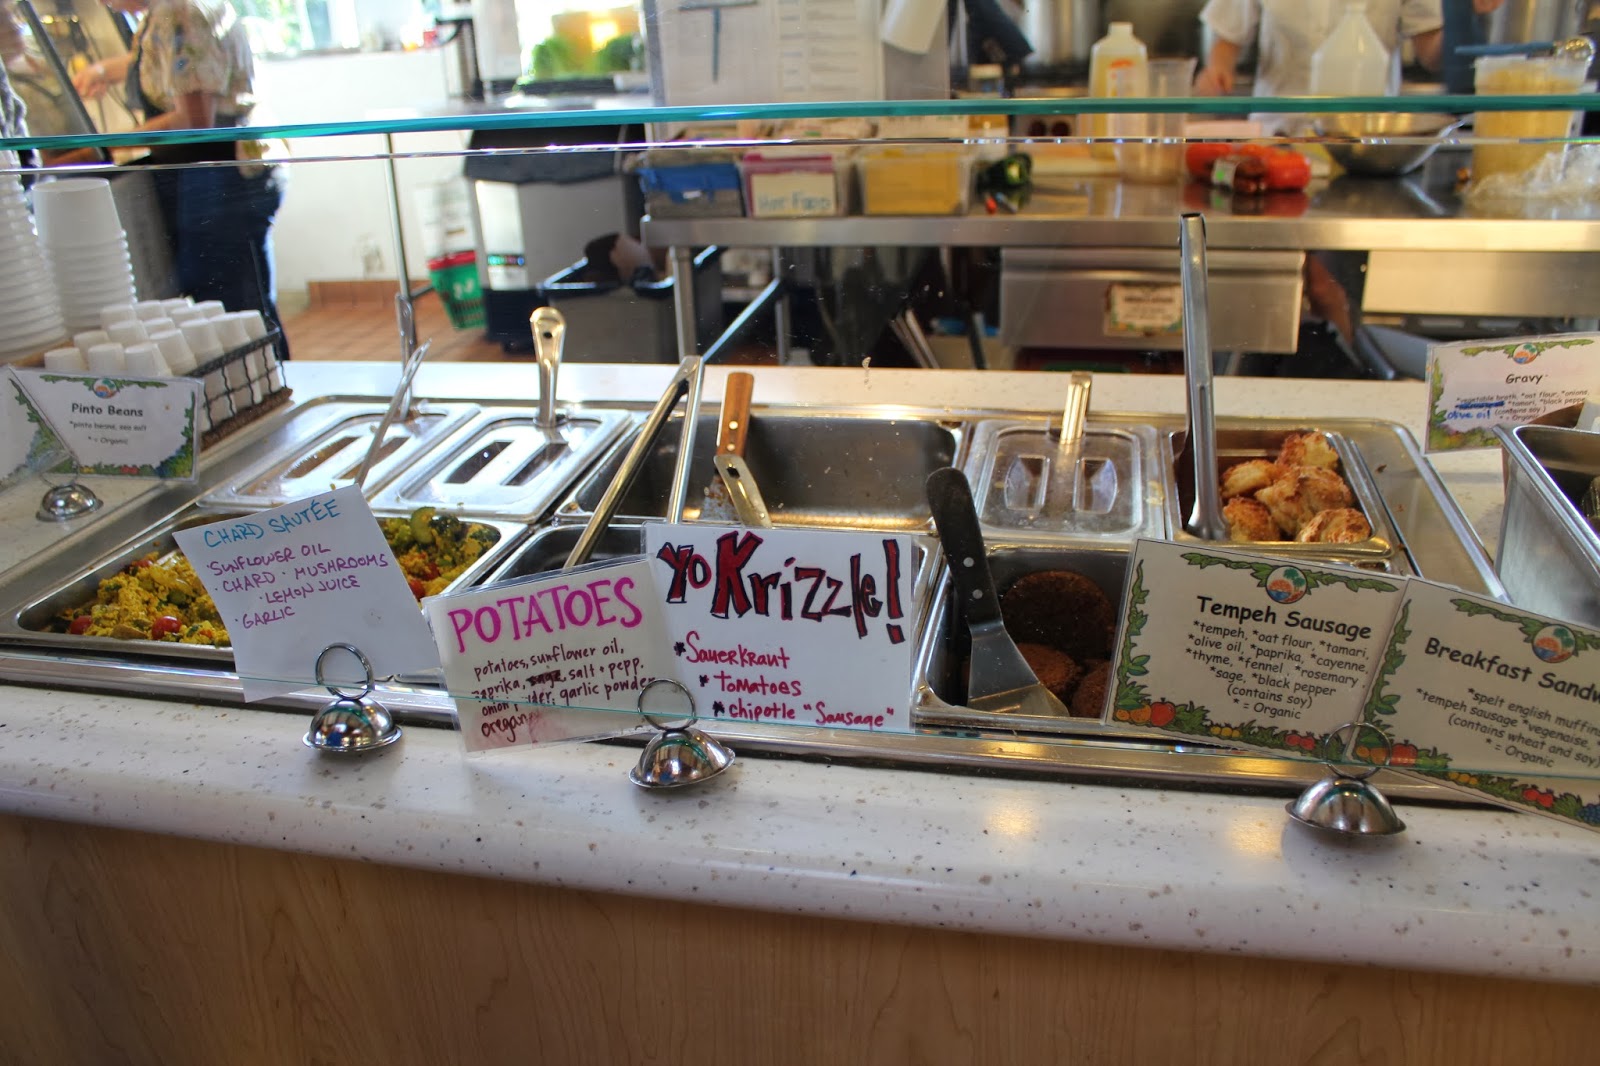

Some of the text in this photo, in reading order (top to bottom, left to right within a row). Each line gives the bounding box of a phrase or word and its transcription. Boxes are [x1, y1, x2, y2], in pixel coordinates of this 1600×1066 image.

[1506, 374, 1543, 384] Gravy
[72, 403, 143, 417] Pinto Beans
[1447, 410, 1490, 419] olive oil
[100, 437, 128, 445] Organic
[204, 499, 341, 548] CHARD SAUTÉE
[210, 543, 331, 576] SUNFLOWER OIL
[222, 554, 388, 593] CHARD MUSHROOMS
[657, 542, 712, 603] Yo
[265, 575, 360, 603] LEMON JUICE
[243, 607, 296, 629] GARLIC
[448, 577, 643, 653] POTATOES
[1197, 596, 1372, 640] Tempeh Sausage
[530, 644, 596, 665] sunflower
[603, 638, 624, 657] oil,
[1226, 640, 1244, 654] oil,
[1282, 634, 1316, 650] flour,
[568, 666, 595, 681] salt
[608, 658, 644, 680] pepp.
[1425, 637, 1532, 682] Breakfast
[560, 682, 599, 706] garlic
[1227, 683, 1313, 709] (contains soy)
[1294, 681, 1336, 697] pepper
[1254, 702, 1301, 720] Organic
[1470, 706, 1518, 728] sausage
[1508, 702, 1551, 721] english
[1448, 713, 1600, 768] (contains wheat and soy)
[1505, 746, 1555, 768] Organic
